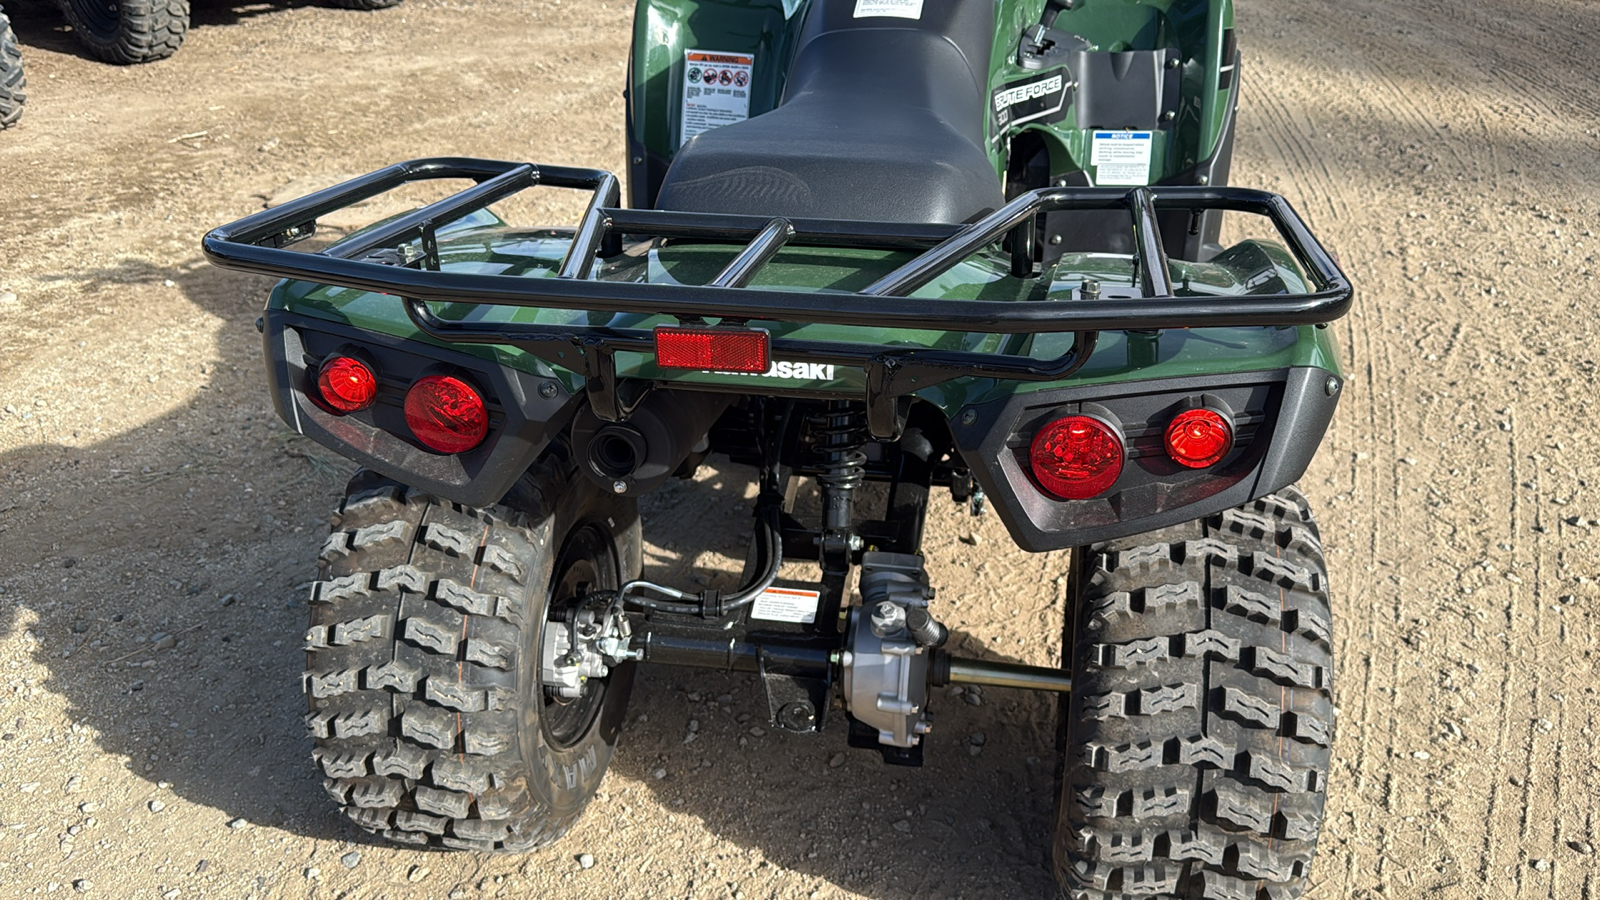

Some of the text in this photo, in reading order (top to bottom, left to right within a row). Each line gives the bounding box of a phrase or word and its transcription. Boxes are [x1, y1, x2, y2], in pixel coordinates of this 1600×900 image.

[995, 77, 1060, 109] BRUTE FORCE
[702, 361, 834, 381] asaki
